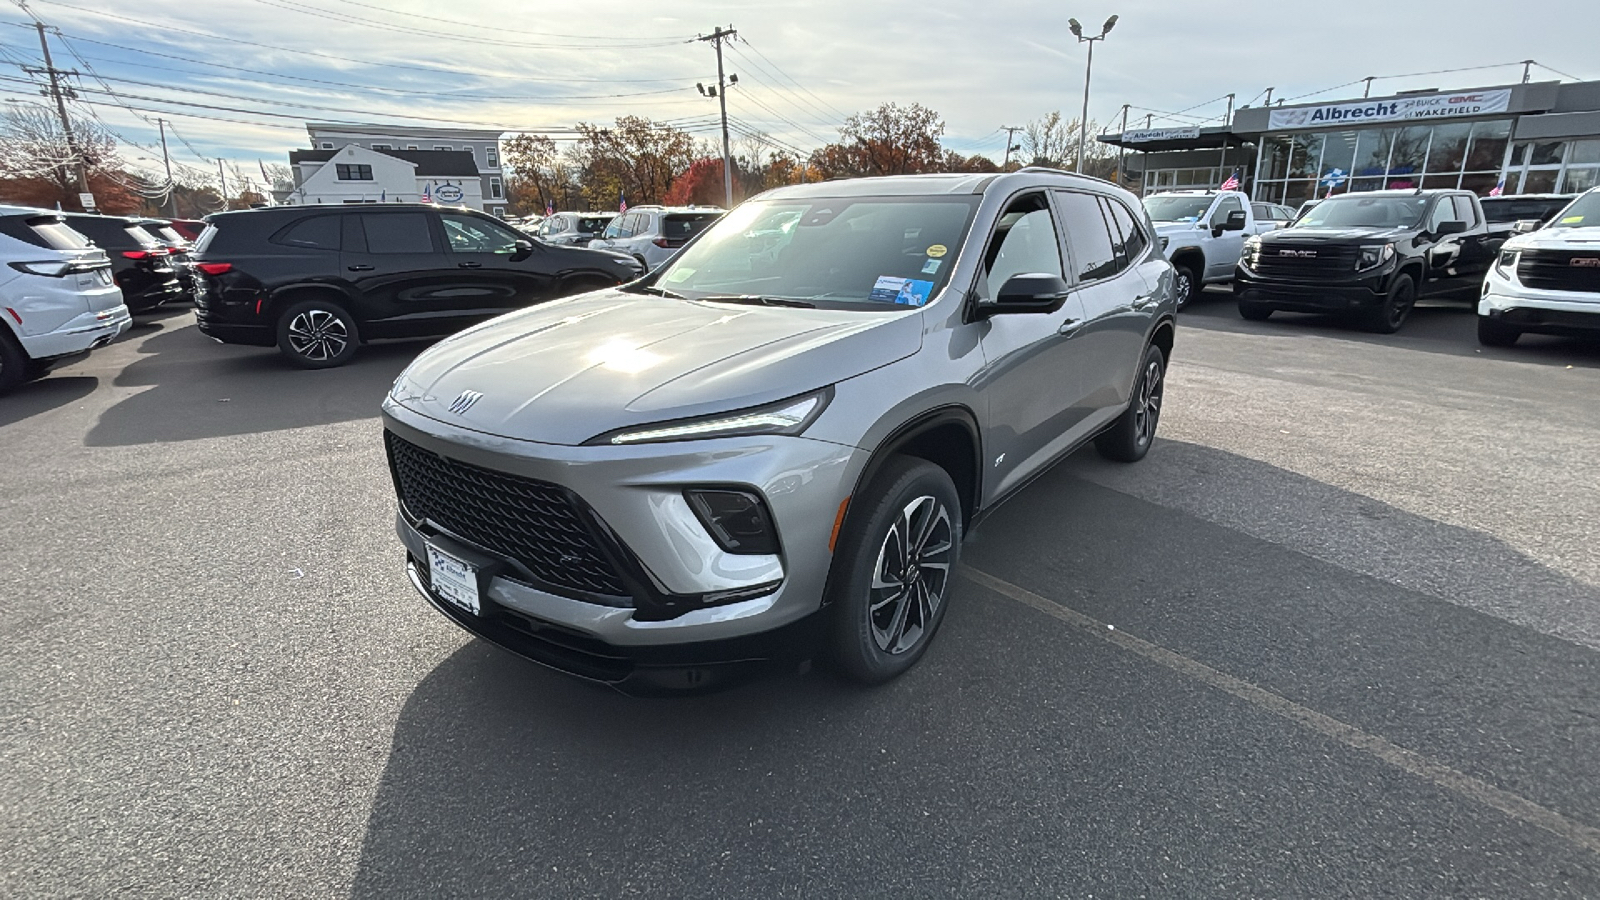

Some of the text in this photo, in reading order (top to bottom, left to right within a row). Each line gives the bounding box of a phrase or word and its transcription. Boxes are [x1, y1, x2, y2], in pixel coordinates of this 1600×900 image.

[1416, 95, 1484, 107] BUICK GMC
[1310, 103, 1398, 121] Albrecht
[1414, 106, 1481, 118] WAKEFIELD
[1134, 131, 1164, 139] Albrecht
[1280, 249, 1318, 258] GMC
